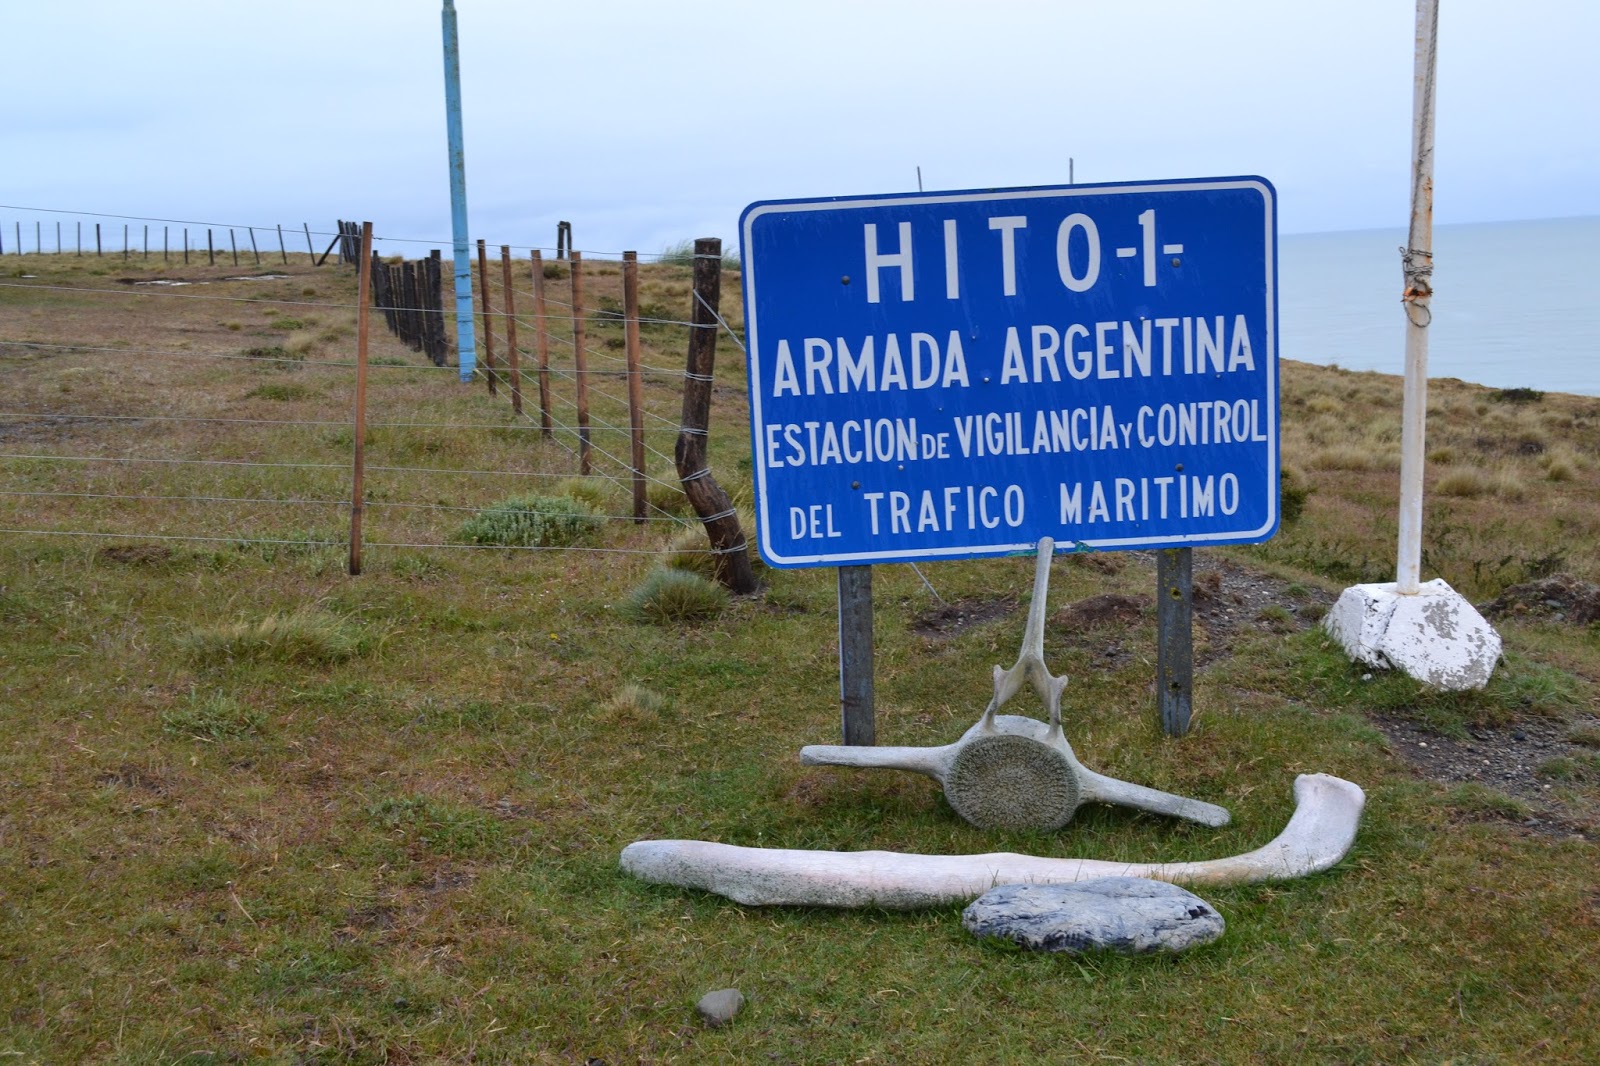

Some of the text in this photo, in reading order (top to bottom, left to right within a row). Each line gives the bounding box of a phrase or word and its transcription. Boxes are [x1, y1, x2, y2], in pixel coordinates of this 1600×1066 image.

[864, 209, 1184, 303] HITO -1-
[773, 314, 1255, 397] ARMADA ARGENTINA
[766, 399, 1267, 468] ESTACION DE VIGILANCIA Y CONTROL
[790, 473, 1240, 540] DEL TRAFICO MARITIMO
